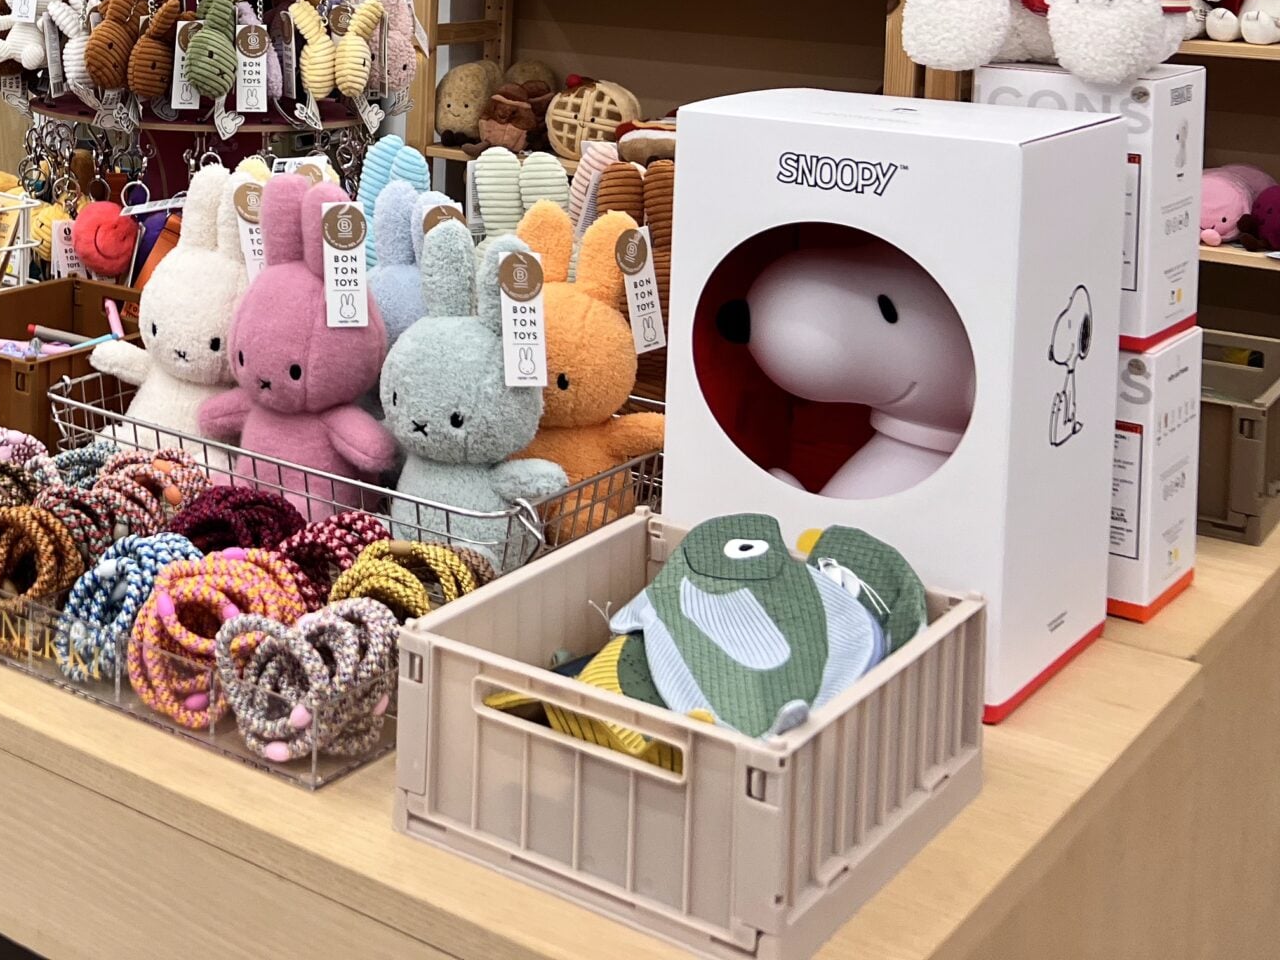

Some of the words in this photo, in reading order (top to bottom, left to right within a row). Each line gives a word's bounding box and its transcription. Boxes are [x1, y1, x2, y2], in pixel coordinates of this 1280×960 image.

[776, 152, 898, 196] SNOOPY
[334, 255, 357, 263] BON
[334, 267, 358, 275] TON
[334, 279, 358, 287] TOYS
[634, 278, 651, 289] BON
[635, 291, 653, 300] TON
[636, 302, 655, 312] TOYS
